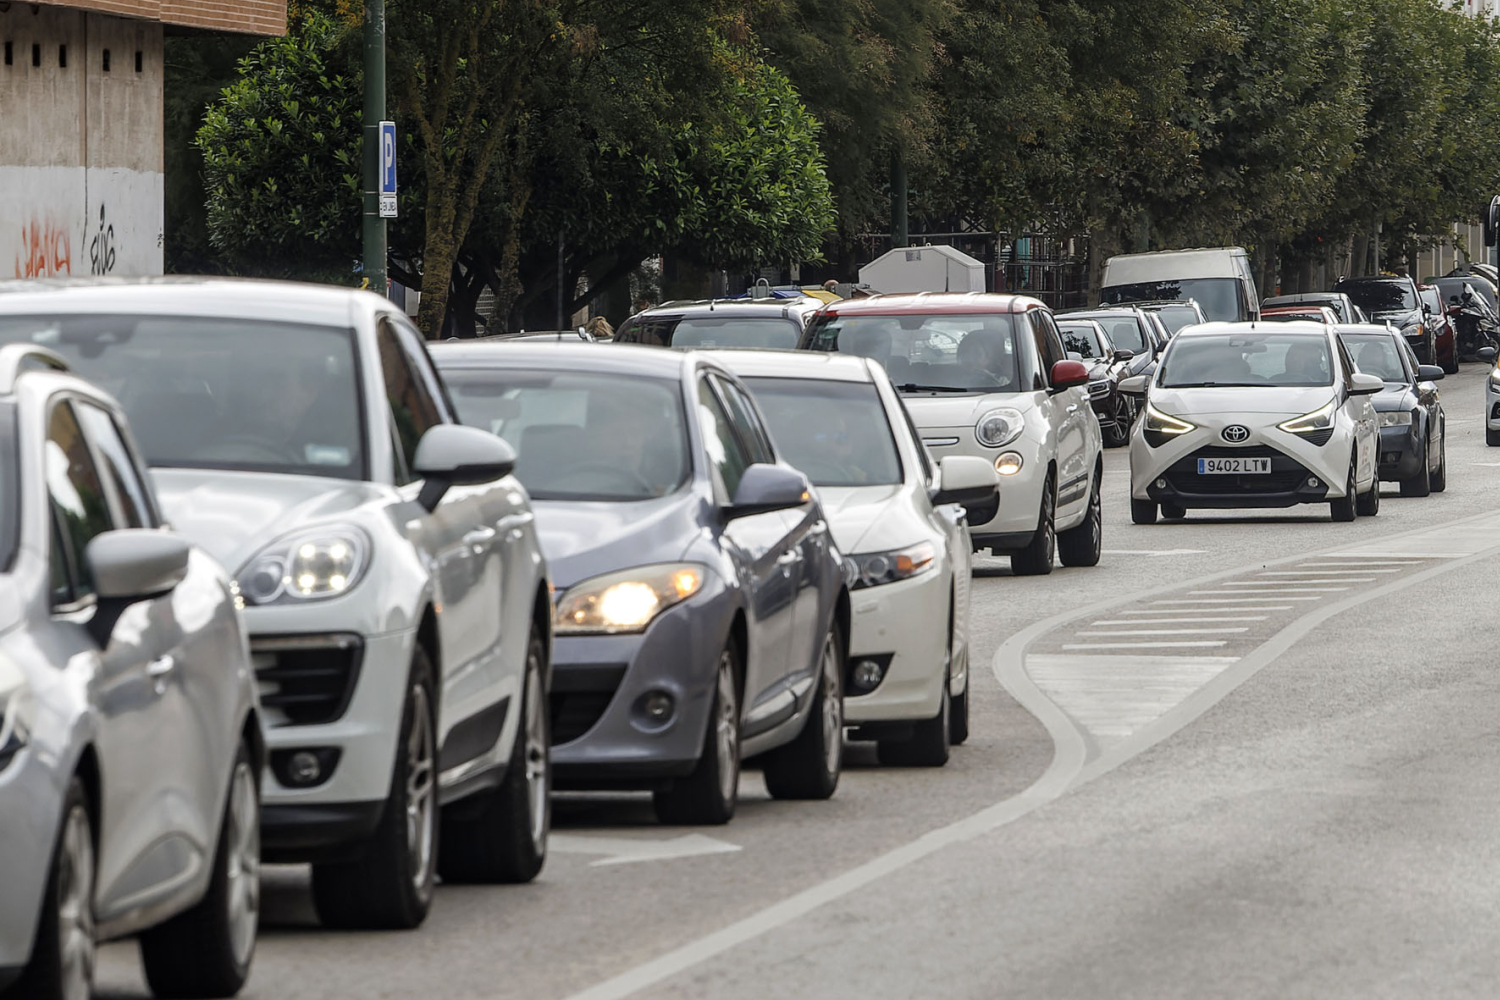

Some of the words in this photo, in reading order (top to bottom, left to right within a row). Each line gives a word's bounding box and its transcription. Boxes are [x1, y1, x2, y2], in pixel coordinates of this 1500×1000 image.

[384, 132, 393, 186] P
[1207, 460, 1240, 472] 9402
[1244, 459, 1268, 472] LTW
